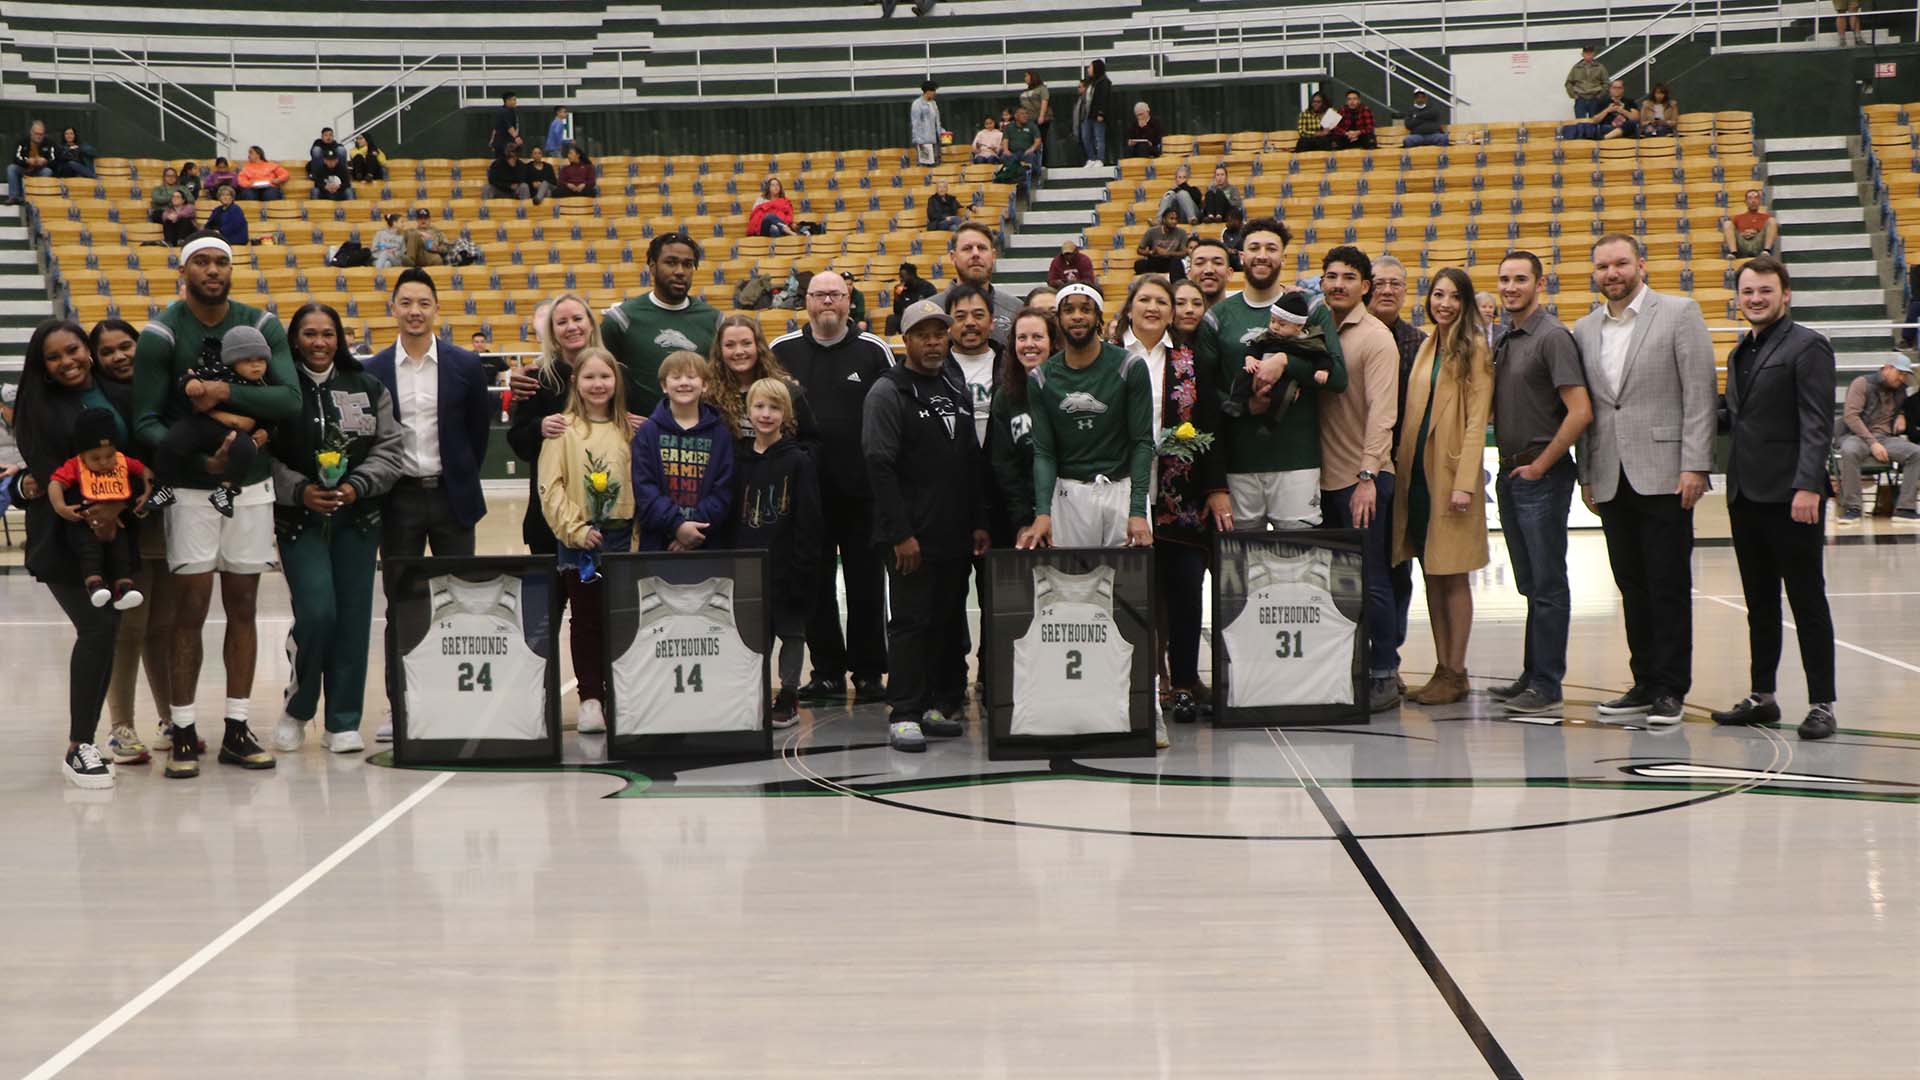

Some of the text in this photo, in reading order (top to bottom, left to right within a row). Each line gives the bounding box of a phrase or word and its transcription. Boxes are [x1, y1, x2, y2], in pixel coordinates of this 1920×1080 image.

[1259, 606, 1321, 625] GREYHOUNDS
[1041, 623, 1107, 643] GREYHOUNDS
[1275, 630, 1303, 658] 31
[442, 636, 508, 655] GREYHOUNDS
[655, 637, 719, 658] GREYHOUNDS
[458, 662, 492, 692] 24
[1066, 650, 1082, 680] 2
[673, 663, 703, 693] 14
